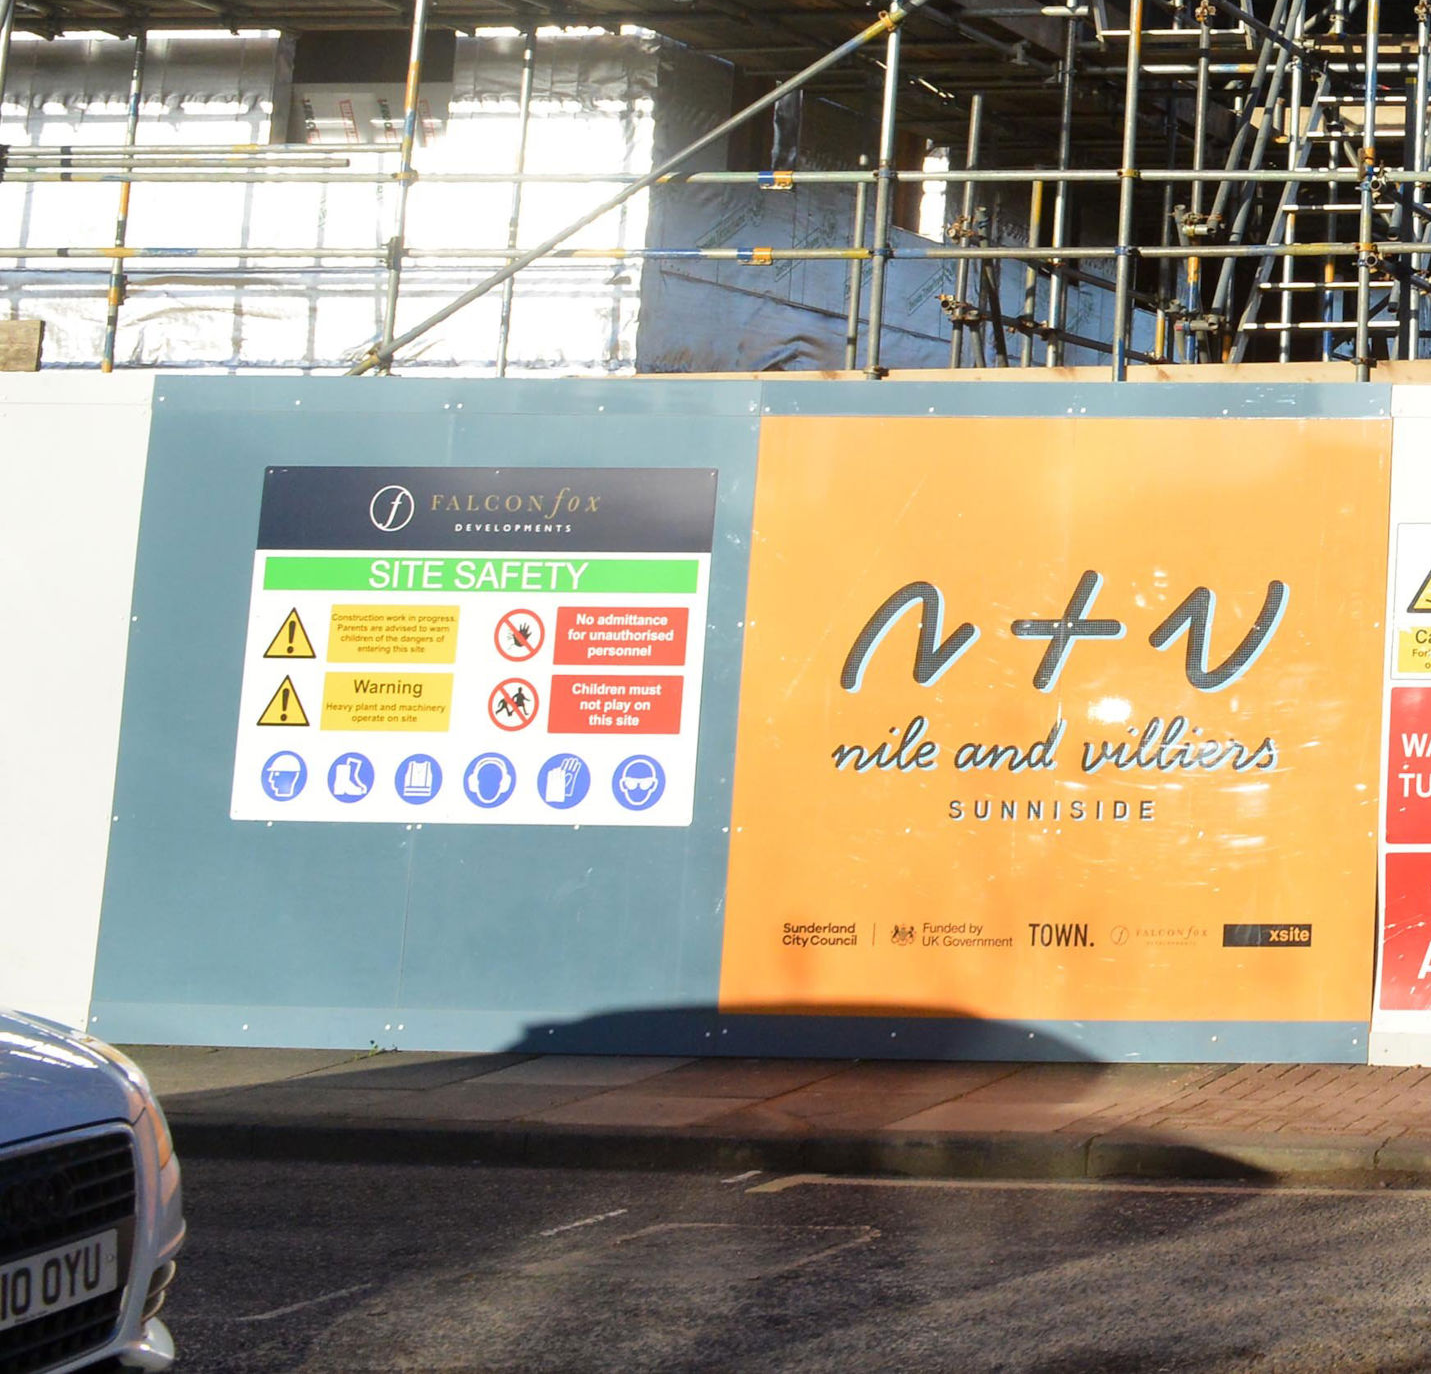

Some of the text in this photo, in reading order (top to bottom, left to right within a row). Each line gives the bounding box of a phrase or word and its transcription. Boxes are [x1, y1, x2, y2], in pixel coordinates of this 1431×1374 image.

[454, 523, 572, 533] DEVELOPMENTS
[368, 560, 589, 590] SITE SAFETY
[331, 613, 384, 622] Construction
[386, 614, 405, 622] work
[576, 613, 668, 626] No admittance
[337, 624, 368, 632] Parents
[385, 624, 417, 632] advised
[340, 634, 373, 642] children
[375, 634, 385, 642] of
[386, 634, 398, 642] the
[400, 635, 434, 644] dangers
[568, 629, 674, 641] for unauthorised
[357, 645, 391, 654] entering
[393, 645, 408, 653] this
[587, 645, 652, 658] personnel
[353, 679, 423, 698] Warning
[571, 683, 662, 695] Children must
[326, 703, 446, 713] Heavy plant and machinery
[579, 699, 651, 713] not play on
[351, 715, 418, 723] operate on site
[588, 715, 640, 726] this site
[831, 714, 1280, 775] nile and villiers
[948, 800, 1156, 822] SUNNISIDE
[783, 922, 856, 934] Sunderland
[922, 923, 983, 936] Funded by
[1268, 926, 1310, 942] xsite
[782, 934, 857, 948] City Council
[922, 936, 1014, 947] UK Government
[1028, 923, 1096, 948] TOWN.
